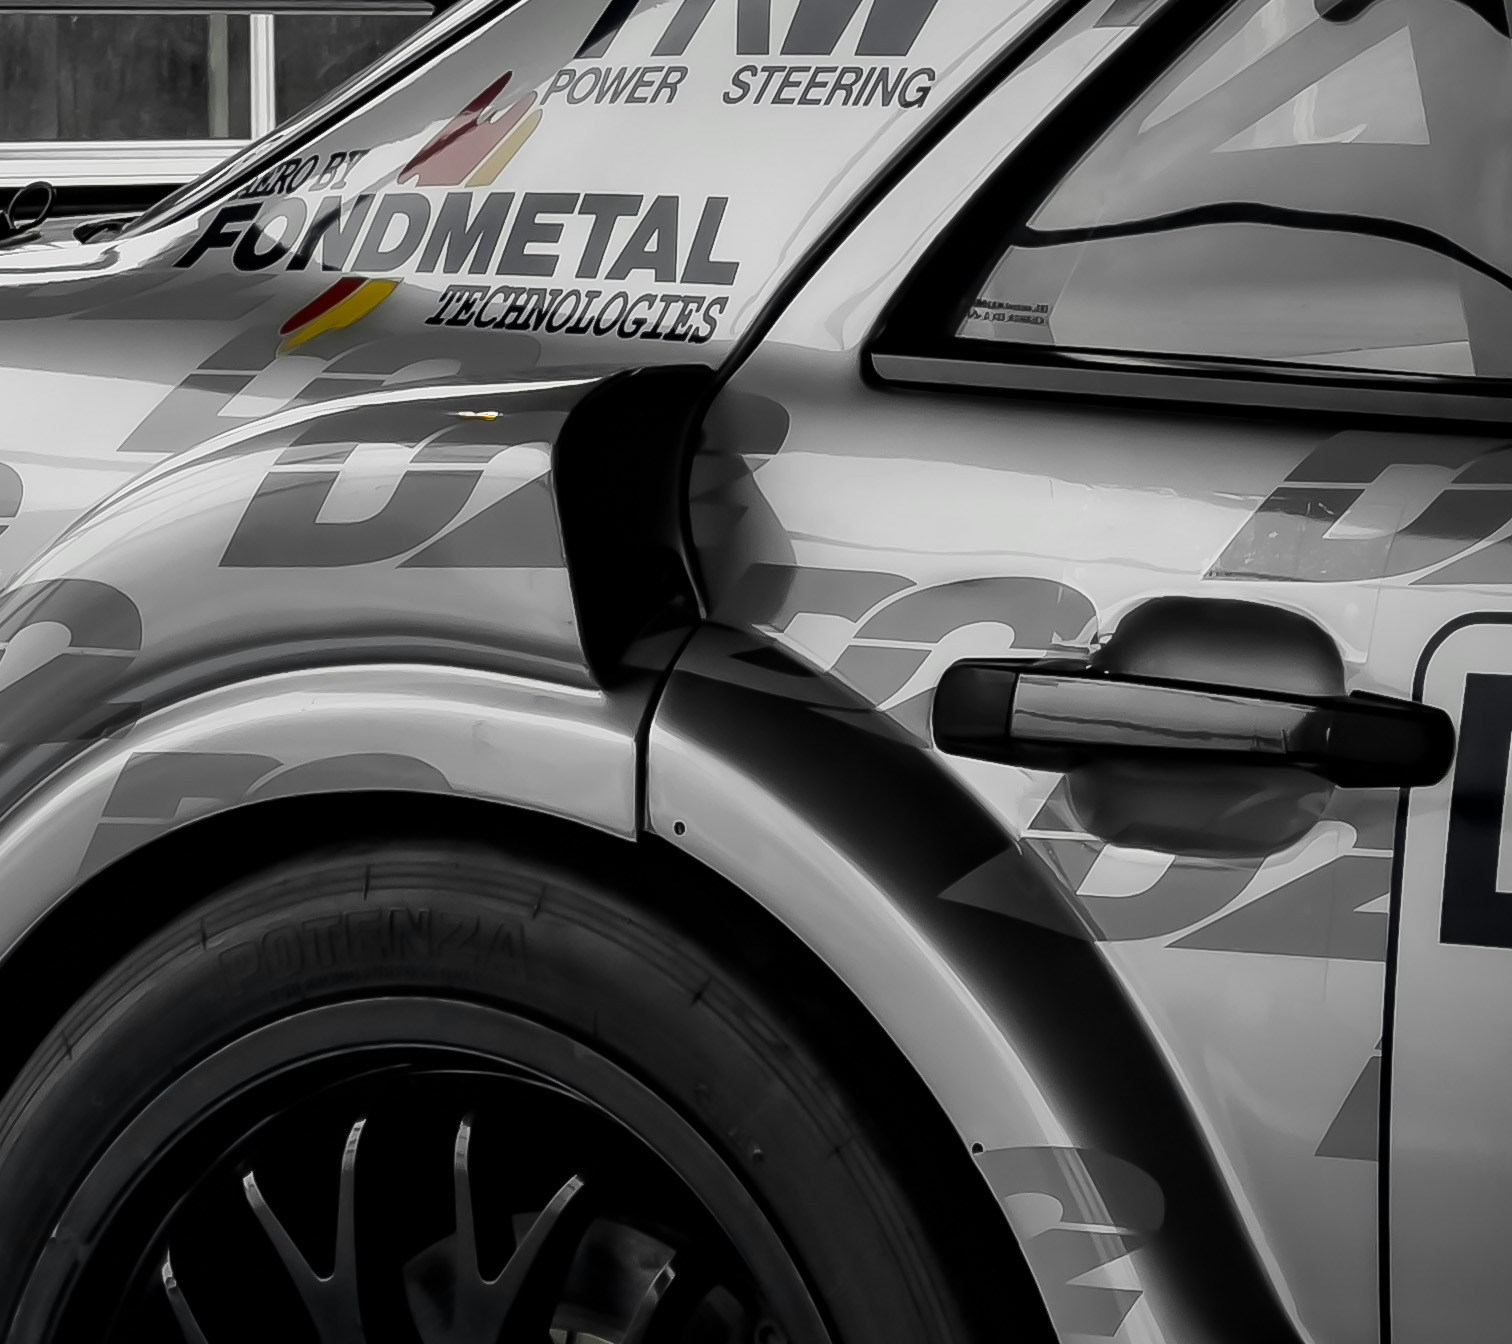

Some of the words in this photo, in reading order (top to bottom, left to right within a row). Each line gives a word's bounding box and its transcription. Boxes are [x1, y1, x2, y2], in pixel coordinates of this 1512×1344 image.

[540, 66, 688, 105] POWER
[723, 65, 935, 108] STEERING
[309, 149, 371, 192] BY
[175, 193, 740, 286] FONDMETAL
[426, 285, 729, 345] TECHNOLOGIES
